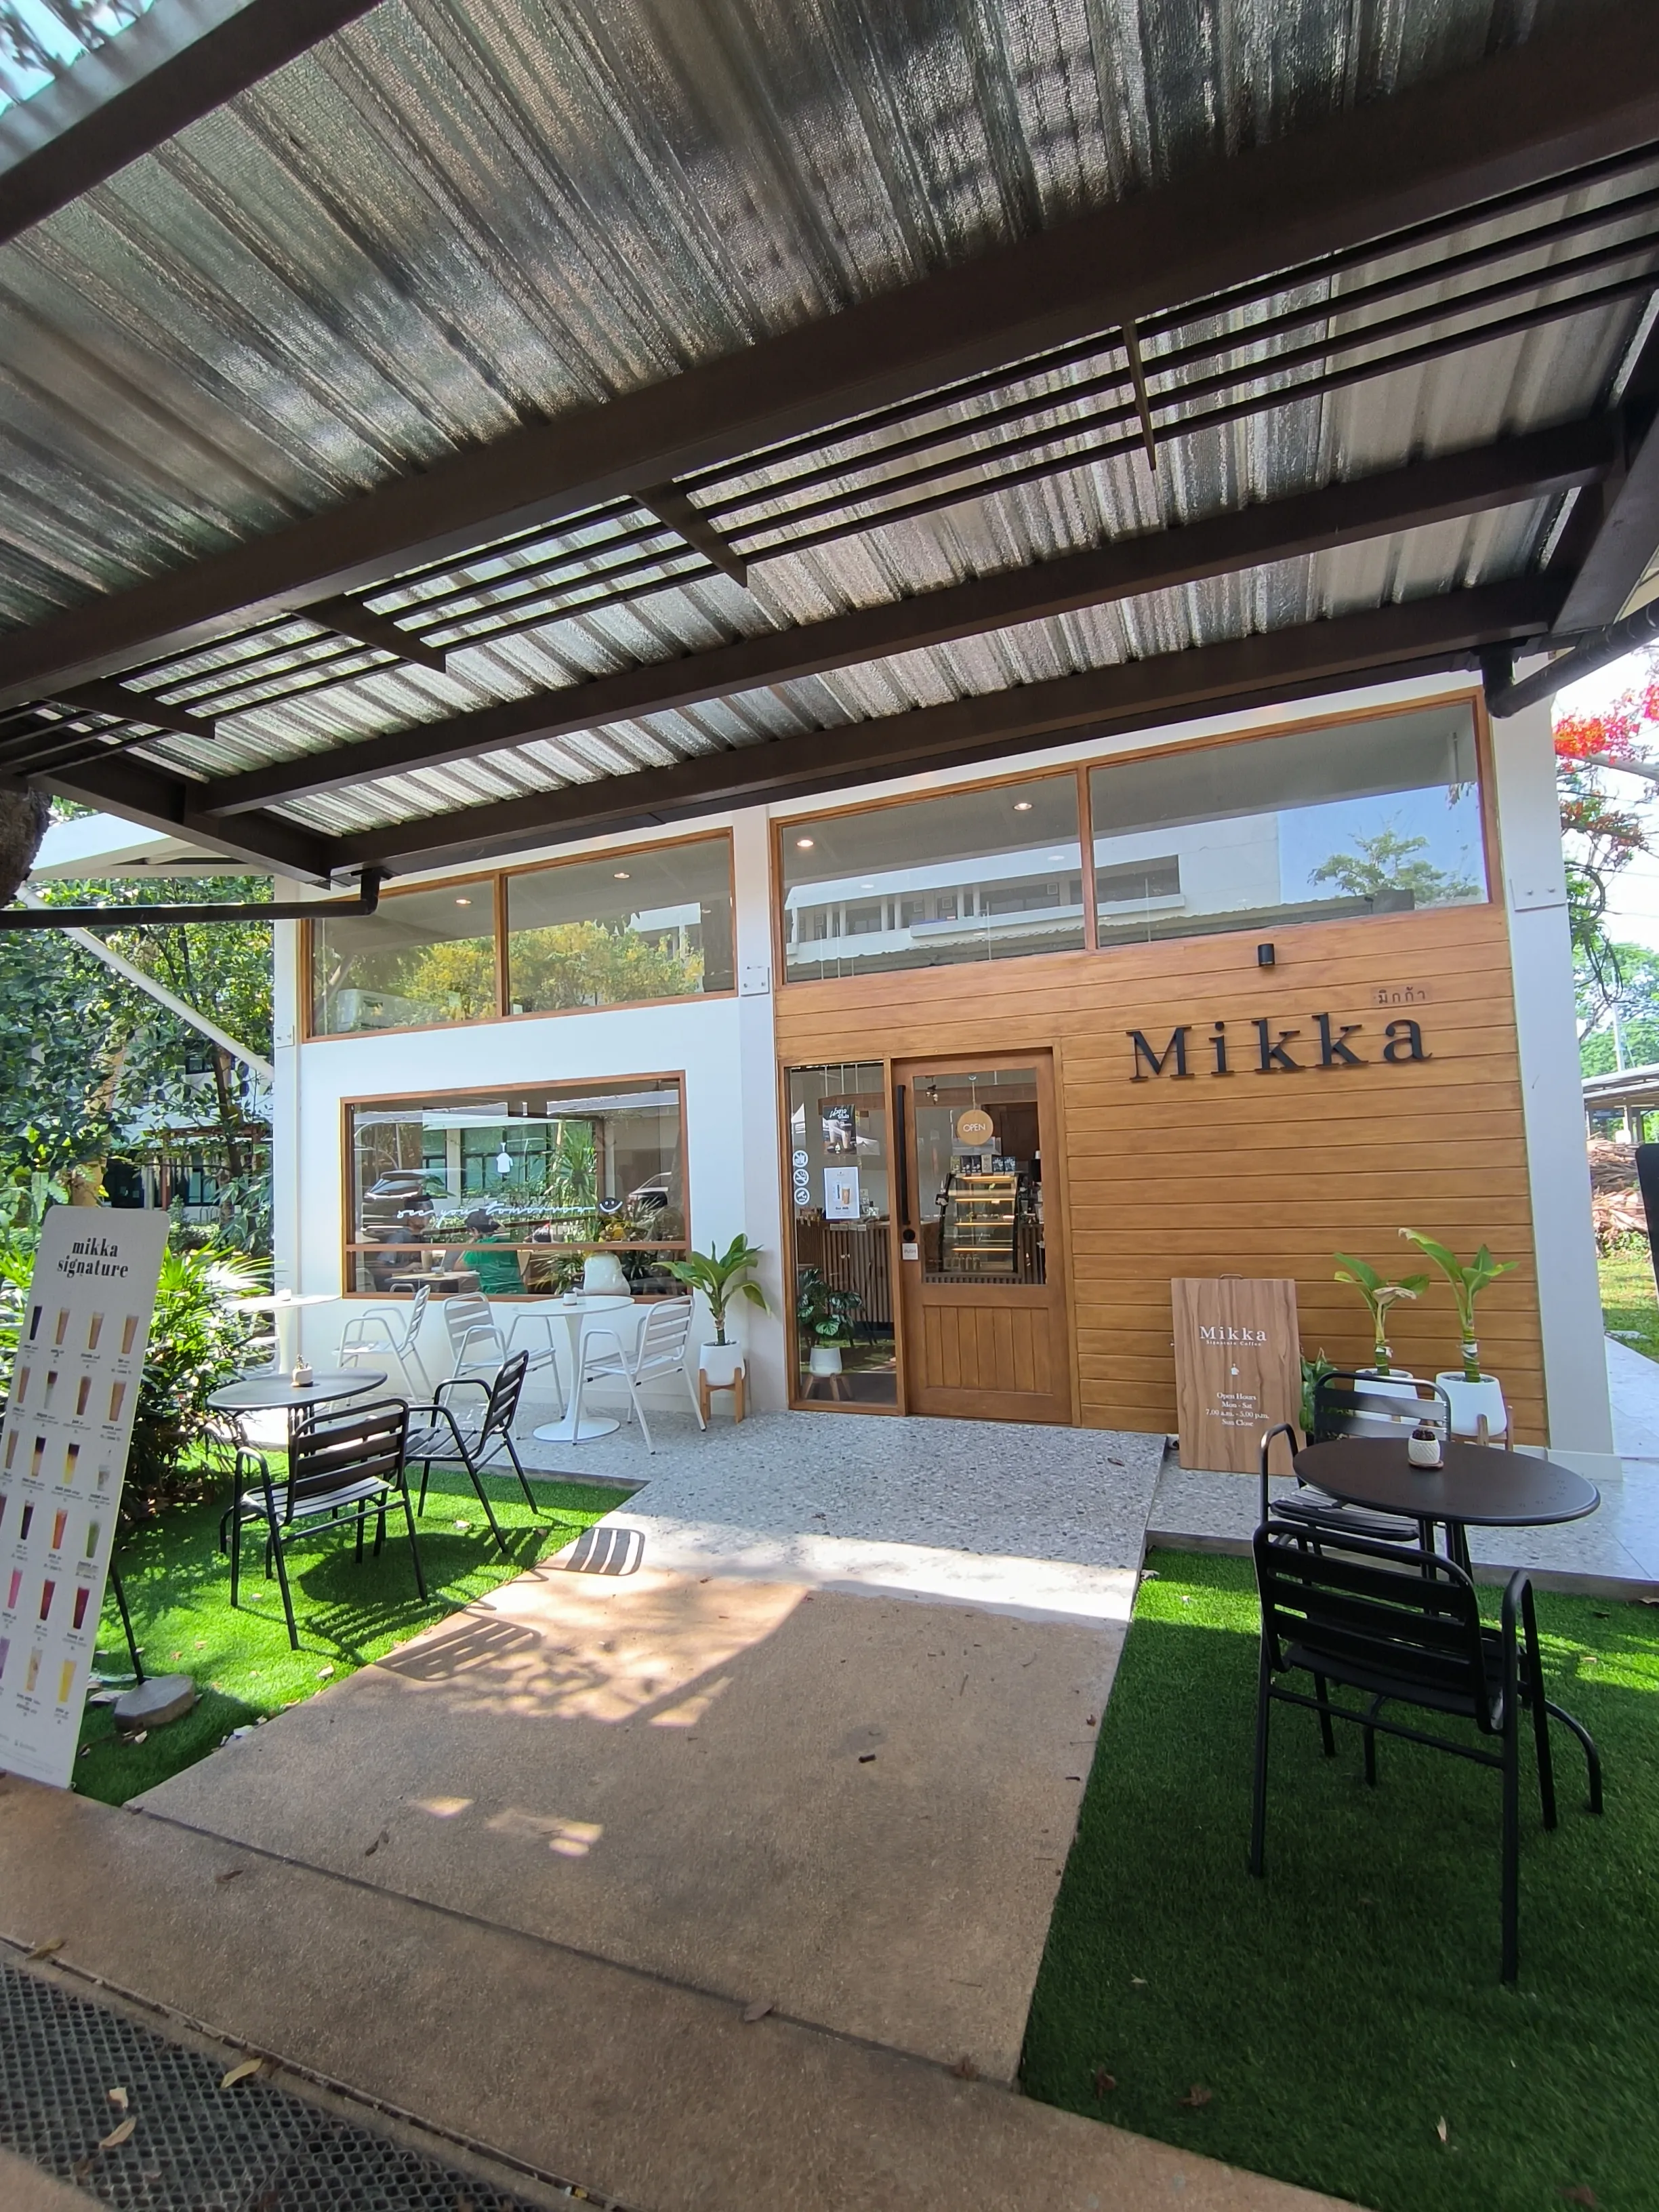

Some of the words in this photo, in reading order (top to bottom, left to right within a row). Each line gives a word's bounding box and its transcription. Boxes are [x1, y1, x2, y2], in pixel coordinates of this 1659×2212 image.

[1378, 986, 1426, 1004] มิกก้า
[1126, 1012, 1433, 1082] Mikka
[963, 1123, 986, 1132] OPEN
[396, 1208, 434, 1219] see
[436, 1208, 479, 1229] you
[484, 1200, 596, 1216] tomorrow
[72, 1237, 119, 1258] mikka
[57, 1255, 129, 1279] signature
[1200, 1326, 1267, 1341] Mikka
[1216, 1392, 1235, 1400] Open
[1236, 1393, 1257, 1401] Hours
